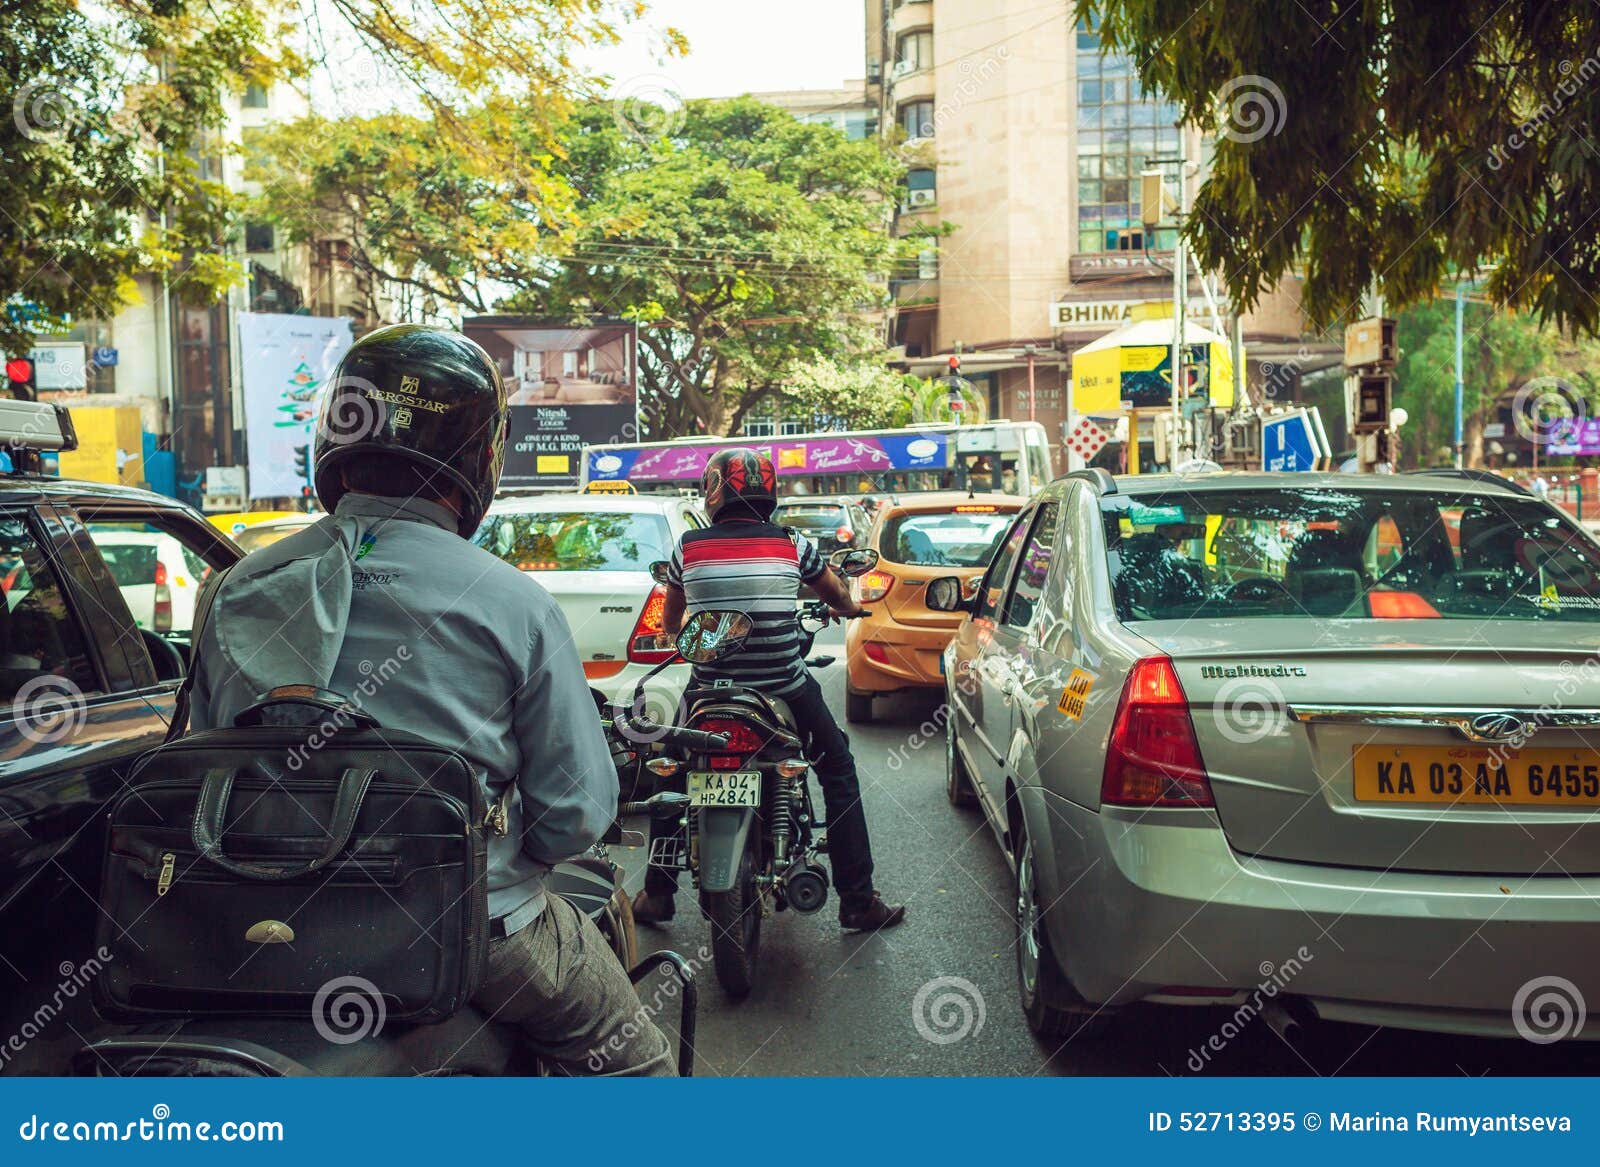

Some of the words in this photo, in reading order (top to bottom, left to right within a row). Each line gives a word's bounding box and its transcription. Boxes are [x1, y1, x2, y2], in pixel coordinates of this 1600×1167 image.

[1058, 305, 1132, 323] BHIMA
[365, 388, 445, 414] AEROSTAR
[525, 434, 541, 442] ONE
[542, 434, 552, 442] OF
[553, 434, 559, 442] A
[560, 434, 580, 442] KIND
[515, 442, 534, 452] OFF
[352, 572, 393, 585] CHOOL
[1201, 664, 1307, 679] Mahindra
[705, 775, 724, 790] KA
[729, 775, 748, 790] 04
[1377, 760, 1416, 794] KA
[1429, 762, 1463, 795] 03
[1474, 763, 1511, 796] AA
[1527, 764, 1600, 797] 6455
